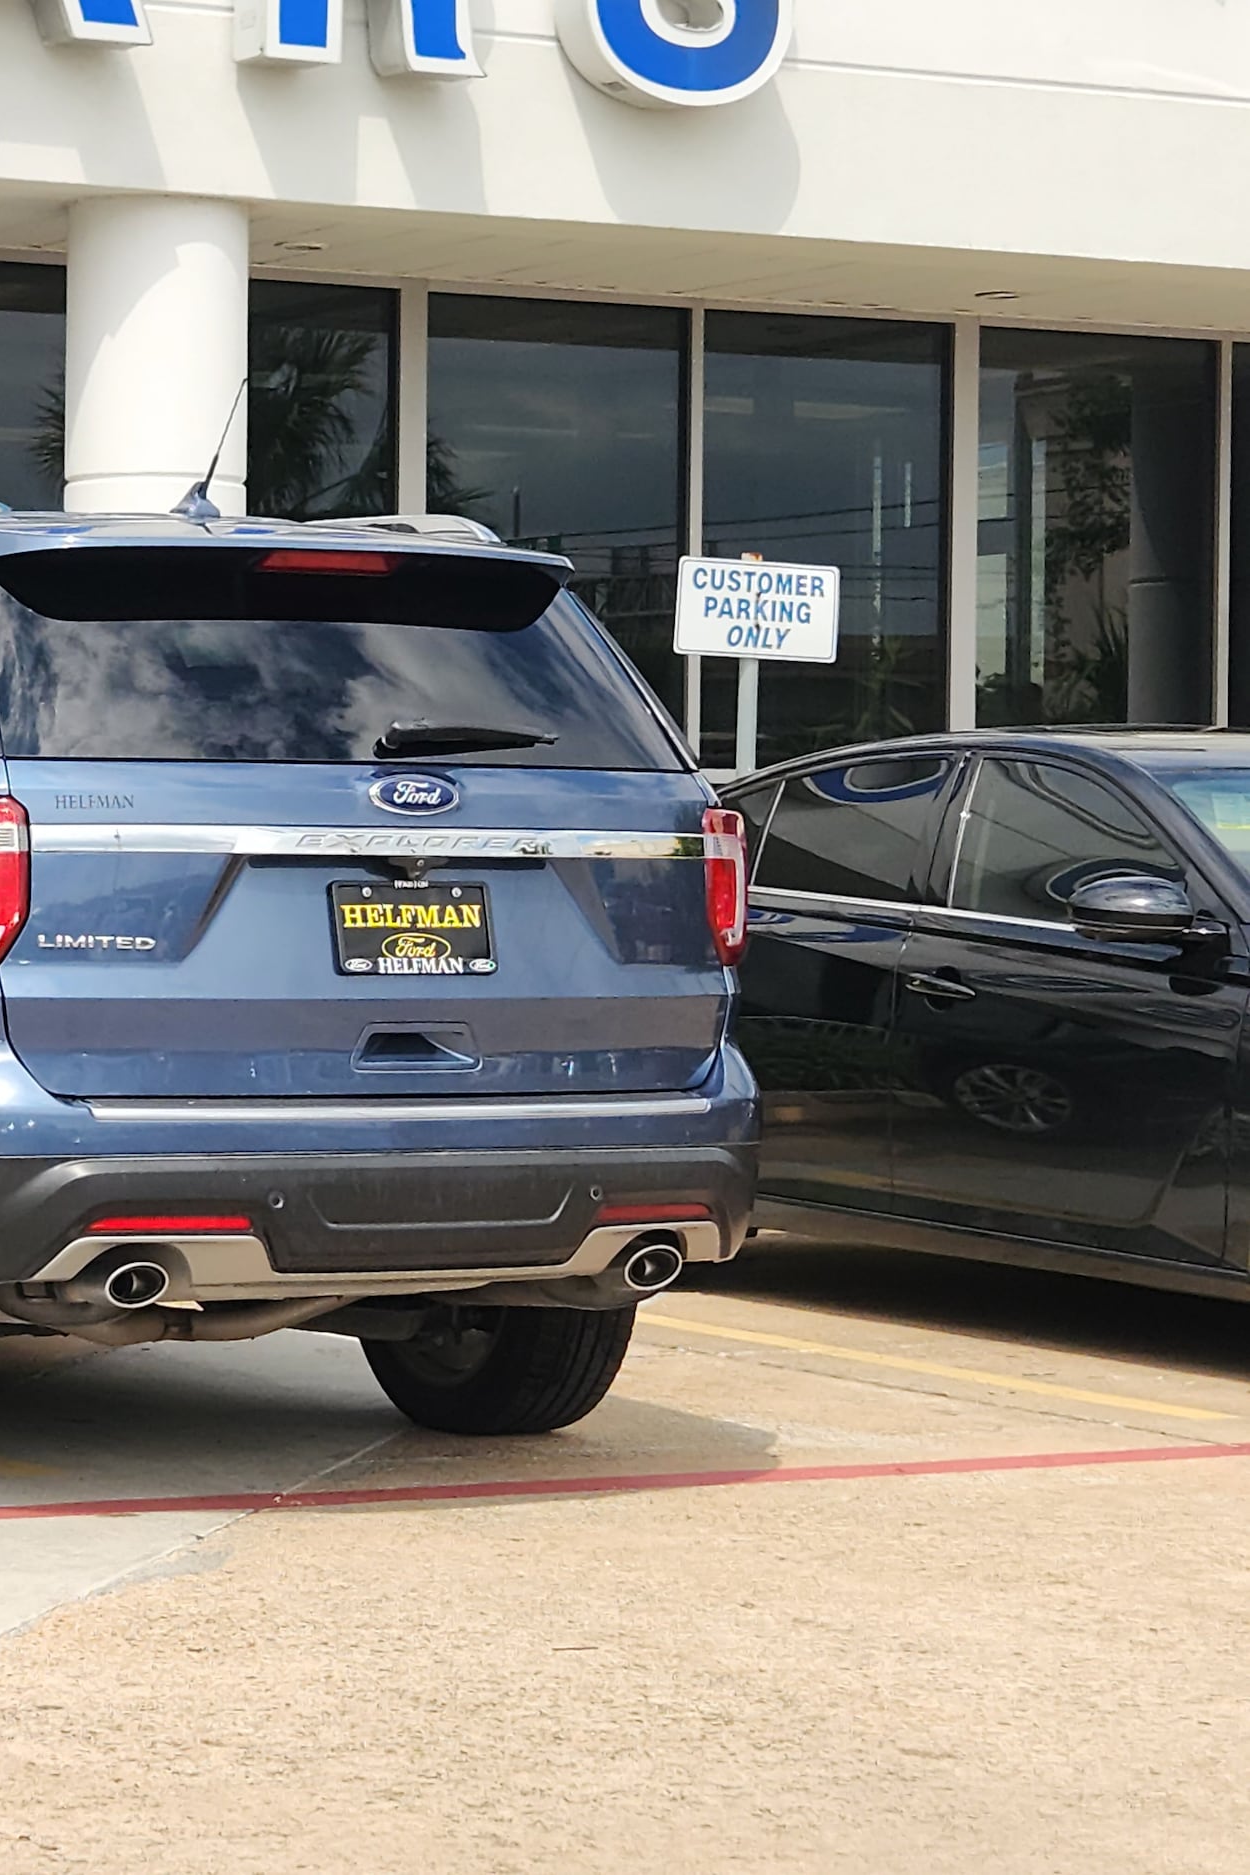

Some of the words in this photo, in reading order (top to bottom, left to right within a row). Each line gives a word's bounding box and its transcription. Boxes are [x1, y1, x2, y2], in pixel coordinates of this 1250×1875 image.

[693, 568, 824, 597] CUSTOMER
[704, 597, 811, 624] PARKING
[727, 626, 791, 649] ONLY
[55, 794, 135, 809] HELFMAN
[393, 781, 441, 804] Ford
[295, 832, 541, 852] EXPLORER
[340, 904, 482, 928] HELFMAN
[38, 934, 157, 950] LIMITED
[395, 937, 437, 958] Ford
[378, 957, 464, 974] HELFMAN
